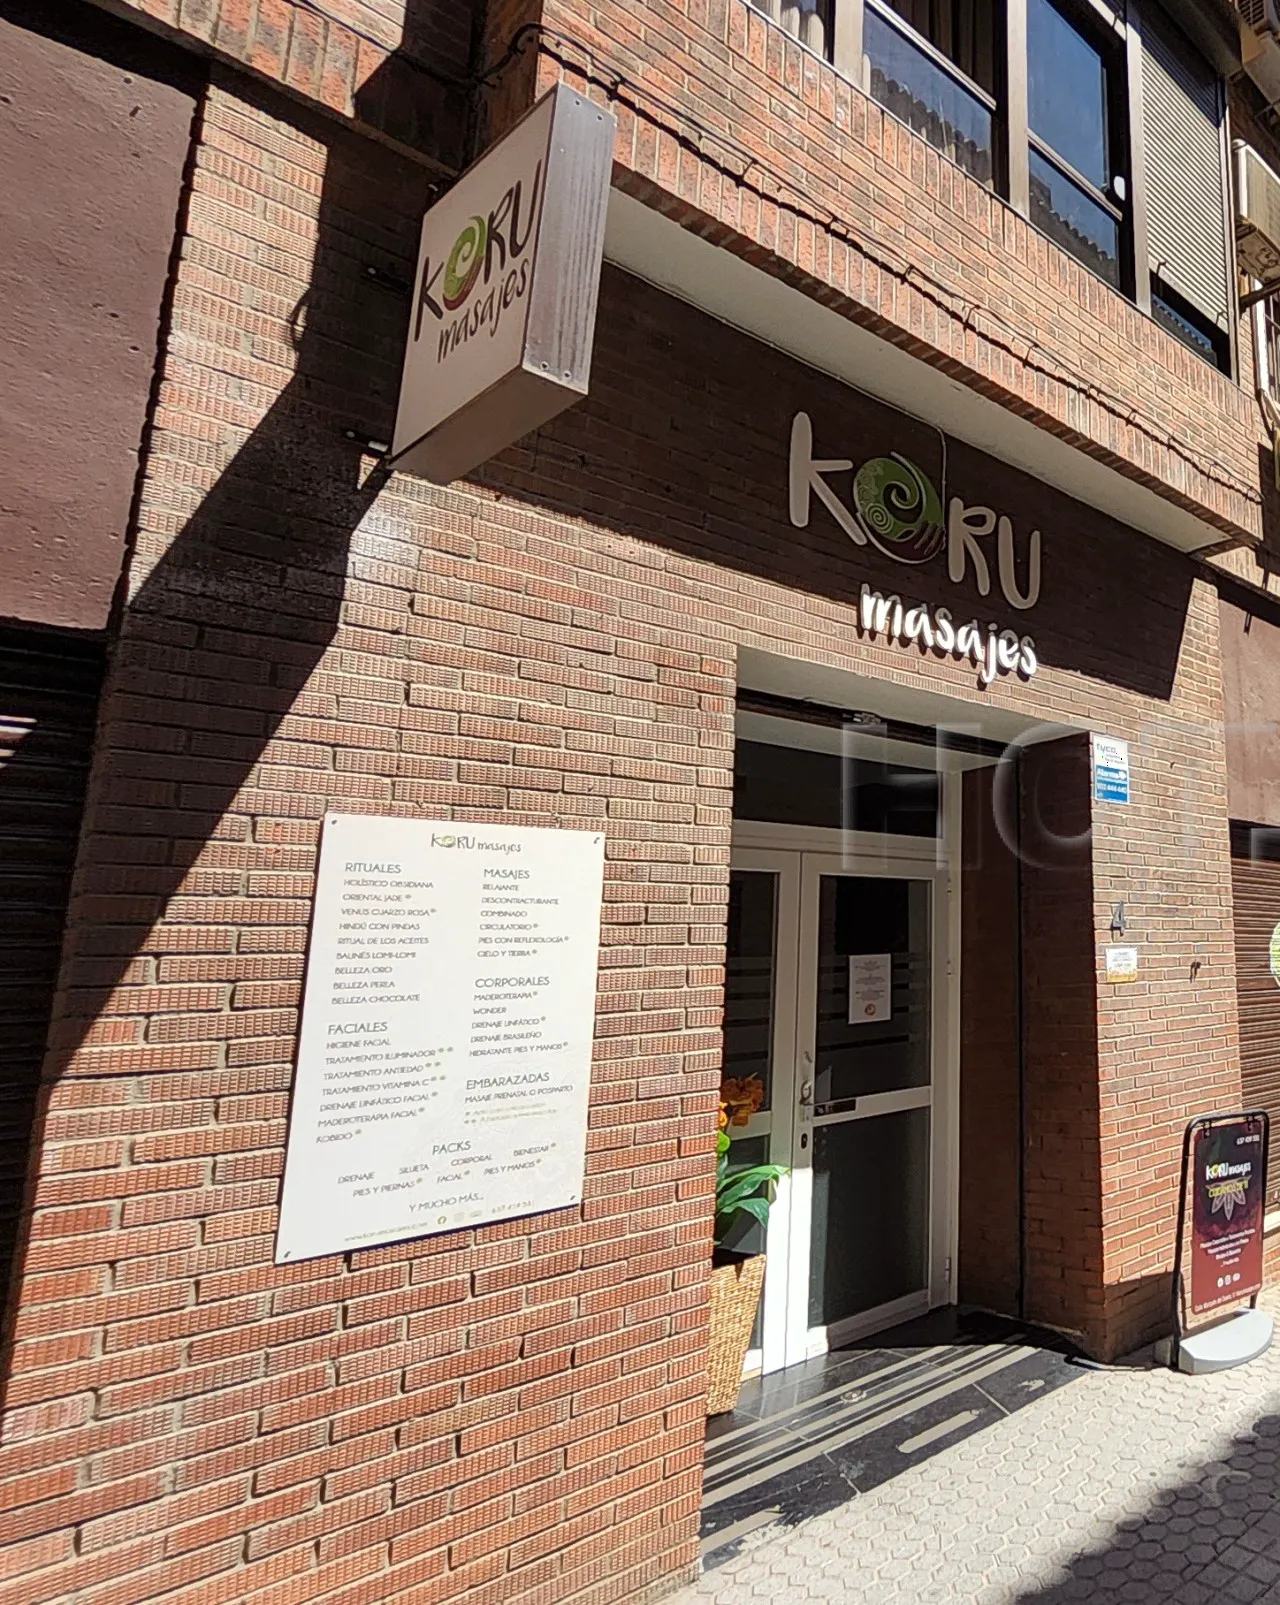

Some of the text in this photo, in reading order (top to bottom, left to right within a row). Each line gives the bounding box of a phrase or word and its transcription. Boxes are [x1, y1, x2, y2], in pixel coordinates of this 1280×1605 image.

[414, 159, 542, 342] KORU
[436, 258, 531, 364] masajes
[789, 410, 1042, 611] KORU
[859, 584, 1038, 686] masajes
[1096, 743, 1116, 753] tyco
[431, 833, 522, 855] KORU masajes
[345, 863, 401, 873] RITUALES
[484, 869, 530, 880] MASAJES
[344, 879, 388, 887] HOLÍSTICO
[384, 894, 402, 902] JADE
[481, 897, 559, 905] DESCONTRACTURANTE
[342, 908, 369, 916] VENUS
[1111, 900, 1127, 937] 4
[338, 937, 365, 945] RITUAL
[475, 977, 550, 988] CORPORALES
[332, 994, 420, 1005] BELLEZA CHOCOLATE
[474, 992, 532, 1001] MADEROTERAPIA
[328, 1021, 388, 1035] FACIALES
[472, 1021, 502, 1029] DRENAJE
[326, 1038, 391, 1049] HIGIENE FACIAL
[470, 1031, 542, 1043] DRENAJE BRASILEÑO
[326, 1049, 436, 1065] TRATAMIENTO ILUMINADOR
[469, 1047, 512, 1057] HIDRATANTE
[514, 1046, 527, 1054] PIES
[535, 1043, 562, 1051] MANOS
[324, 1065, 424, 1080] TRATAMIENTO ANTIEDAD
[322, 1084, 380, 1096] TRATAMIENTO
[382, 1080, 420, 1090] VITAMINA
[466, 1072, 550, 1090] EMBARAZADAS
[320, 1101, 357, 1112] DRENAJE
[403, 1094, 429, 1102] FACIAL
[465, 1093, 491, 1103] MASAJE
[494, 1090, 527, 1100] PRENATAL
[318, 1109, 417, 1128] MADEROTERAPIA FACIAL
[316, 1132, 352, 1144] KOBIDO
[432, 1140, 471, 1156] PACKS
[337, 1145, 549, 1185] DRENAJE SILUETA CORPORAL BIENESTAR
[352, 1161, 536, 1198] PIES Y PIERNAS FACIAL PIES Y MANOS
[409, 1204, 417, 1213] Y
[418, 1196, 456, 1211] MUCHO
